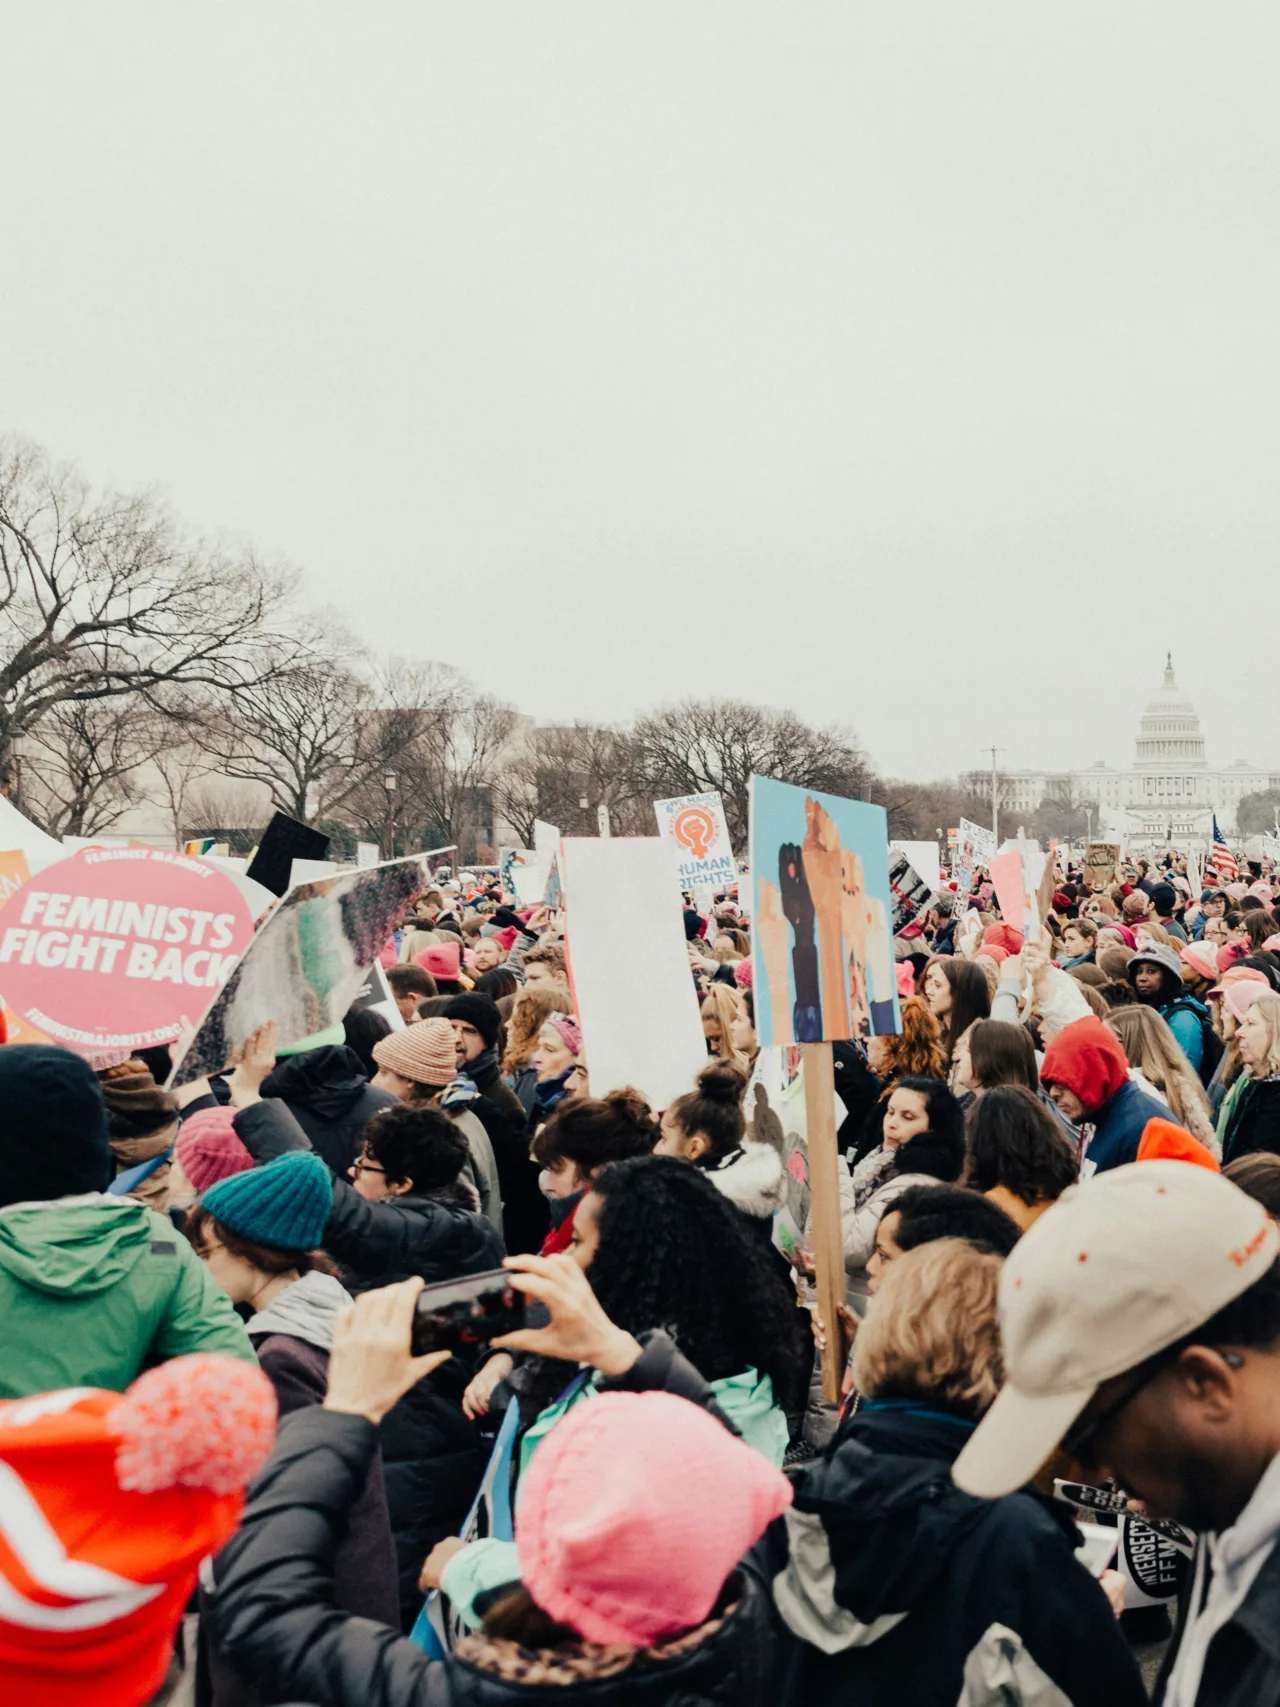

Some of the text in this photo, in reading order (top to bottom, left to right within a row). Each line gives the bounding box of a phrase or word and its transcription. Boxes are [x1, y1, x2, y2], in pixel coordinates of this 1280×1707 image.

[84, 848, 215, 878] FEMINIST MAJORITY
[20, 891, 236, 950] FEMINISTS
[0, 927, 241, 987] FIGHT BACK
